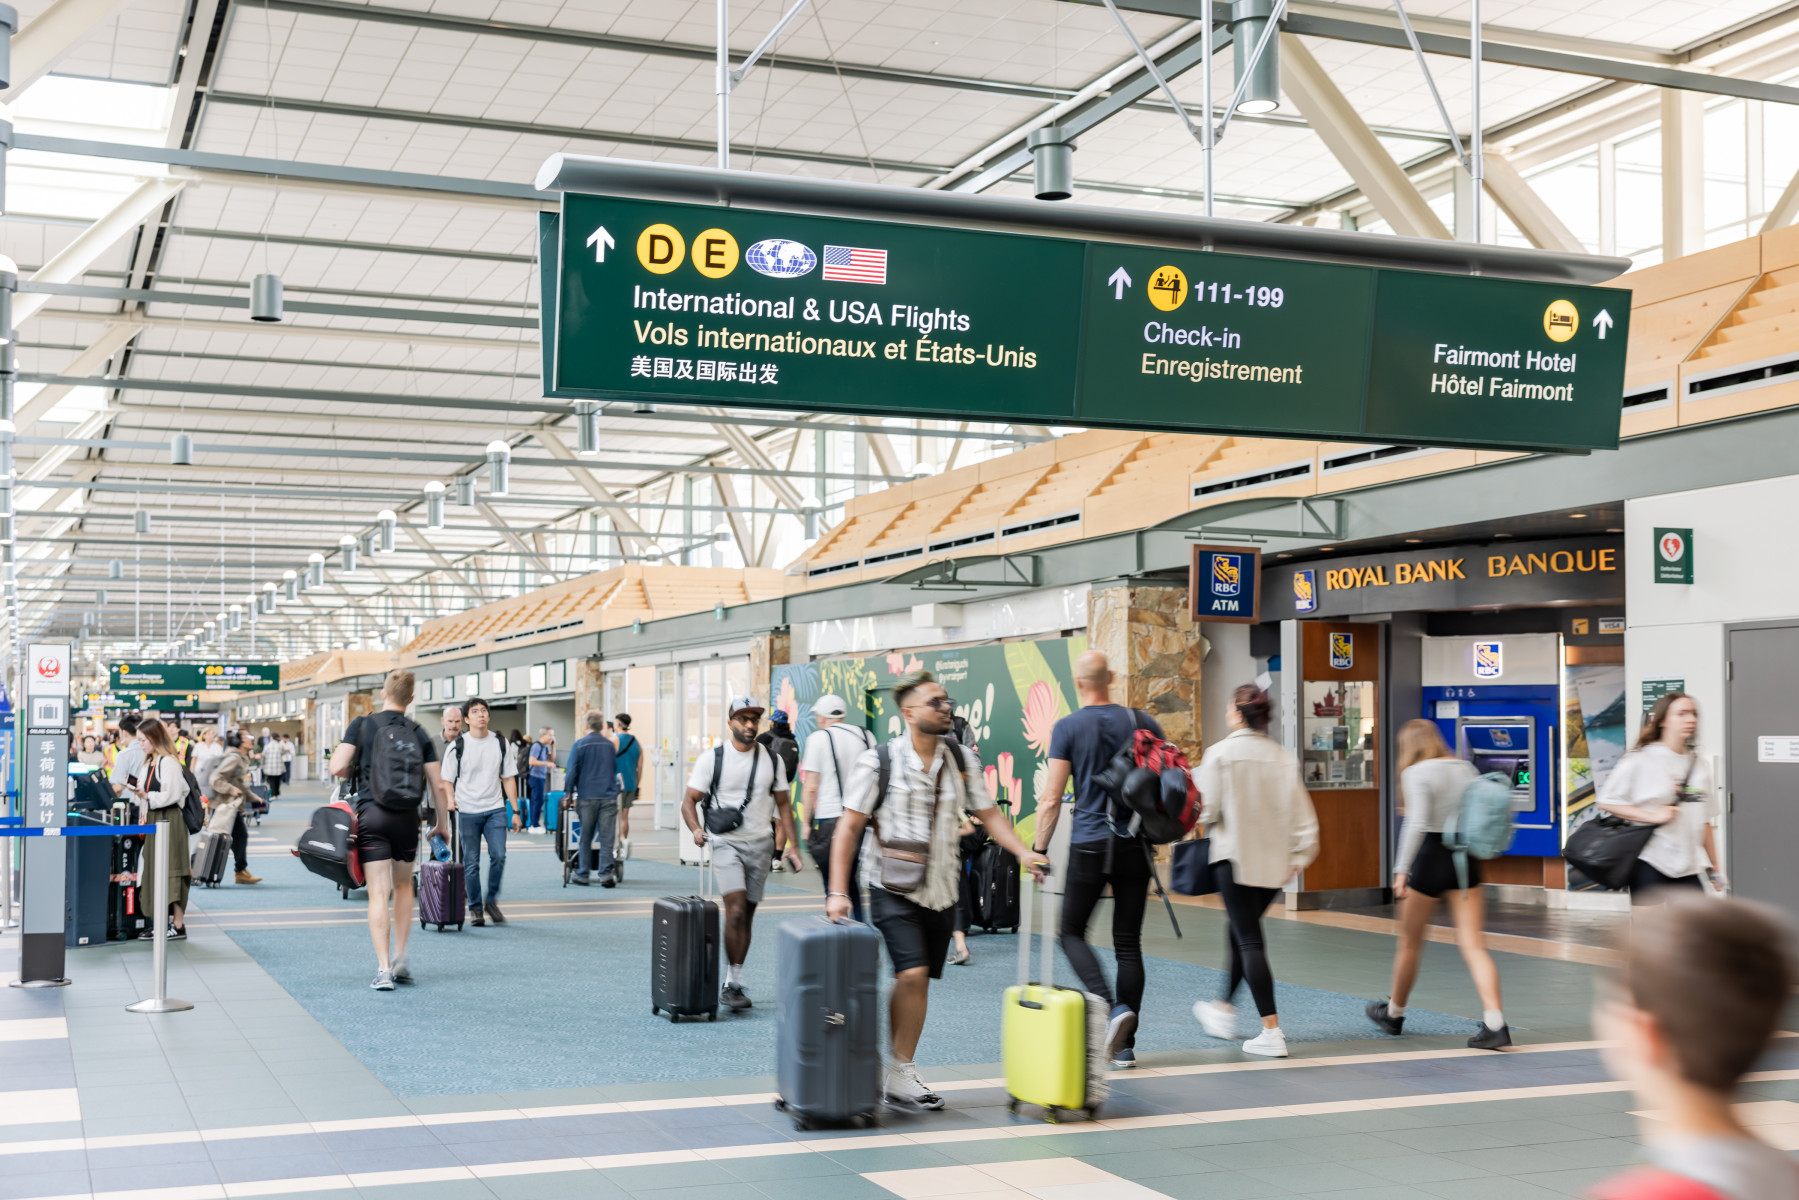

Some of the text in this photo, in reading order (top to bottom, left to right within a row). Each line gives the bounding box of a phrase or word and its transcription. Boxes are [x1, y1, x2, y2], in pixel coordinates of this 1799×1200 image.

[648, 233, 727, 270] D E
[633, 284, 971, 334] International & USA Flights
[1194, 280, 1285, 309] 111-199
[633, 319, 1037, 370] Vols internationaux et États-Unis
[1143, 321, 1241, 349] Check-in
[630, 354, 779, 385] 美国及国际出发
[1141, 352, 1303, 385] Enregistrement
[1433, 343, 1577, 373] Fairmont Hotel
[1430, 371, 1575, 402] Hôtel Fairmont
[1326, 558, 1466, 591] ROYAL BANK
[1487, 548, 1616, 578] BANQUE
[1214, 583, 1237, 593] RBC
[1211, 599, 1239, 612] ATM
[1333, 658, 1351, 666] RBC
[1477, 666, 1499, 675] RBC
[39, 740, 55, 824] 手荷物預け
